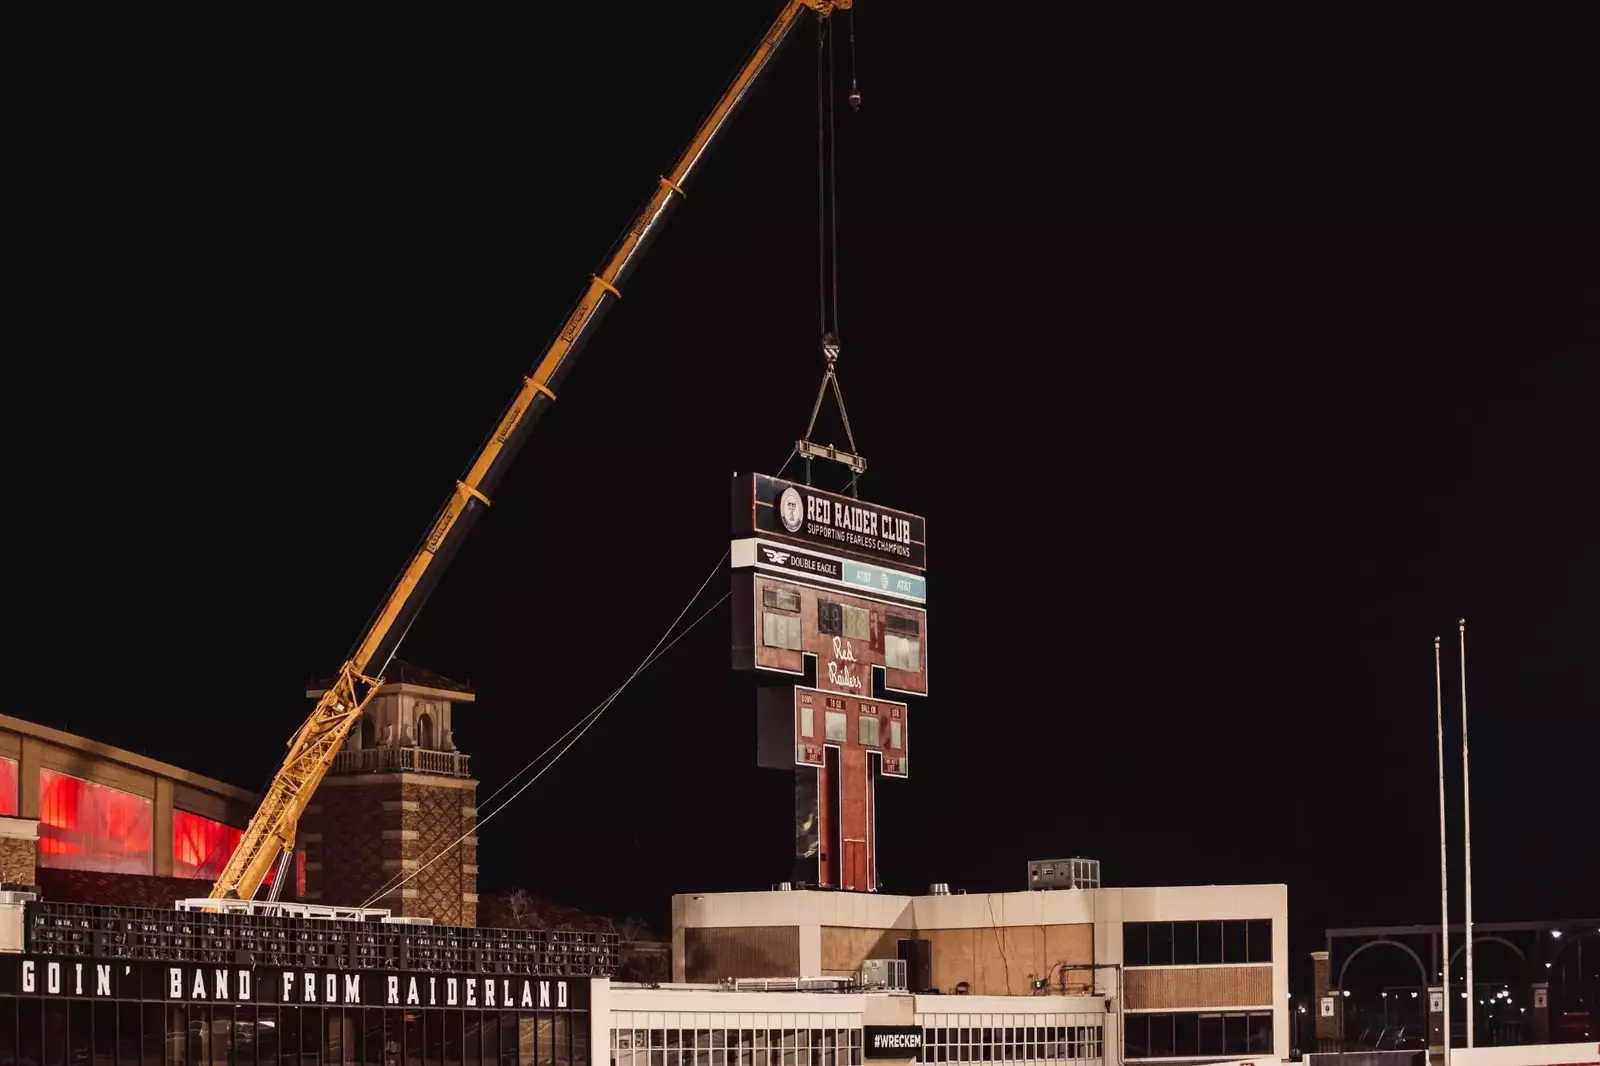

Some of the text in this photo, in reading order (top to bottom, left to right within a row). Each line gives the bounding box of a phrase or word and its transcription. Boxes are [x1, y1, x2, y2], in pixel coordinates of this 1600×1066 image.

[807, 495, 831, 524] RED
[834, 503, 878, 537] RAIDER
[882, 515, 911, 545] CLUB
[807, 523, 910, 558] SUPPORTING FEARLESS CHAMPIONS
[790, 555, 837, 575] DOUBLE EAGLE
[856, 570, 872, 583] AT&T
[896, 579, 912, 592] AT&T
[832, 636, 858, 662] Red
[827, 662, 862, 689] Raiders
[861, 704, 870, 714] BALL
[22, 960, 568, 1008] GOIN' BAND FROM RAIDERLAND
[874, 1034, 921, 1048] #WRECKEM
